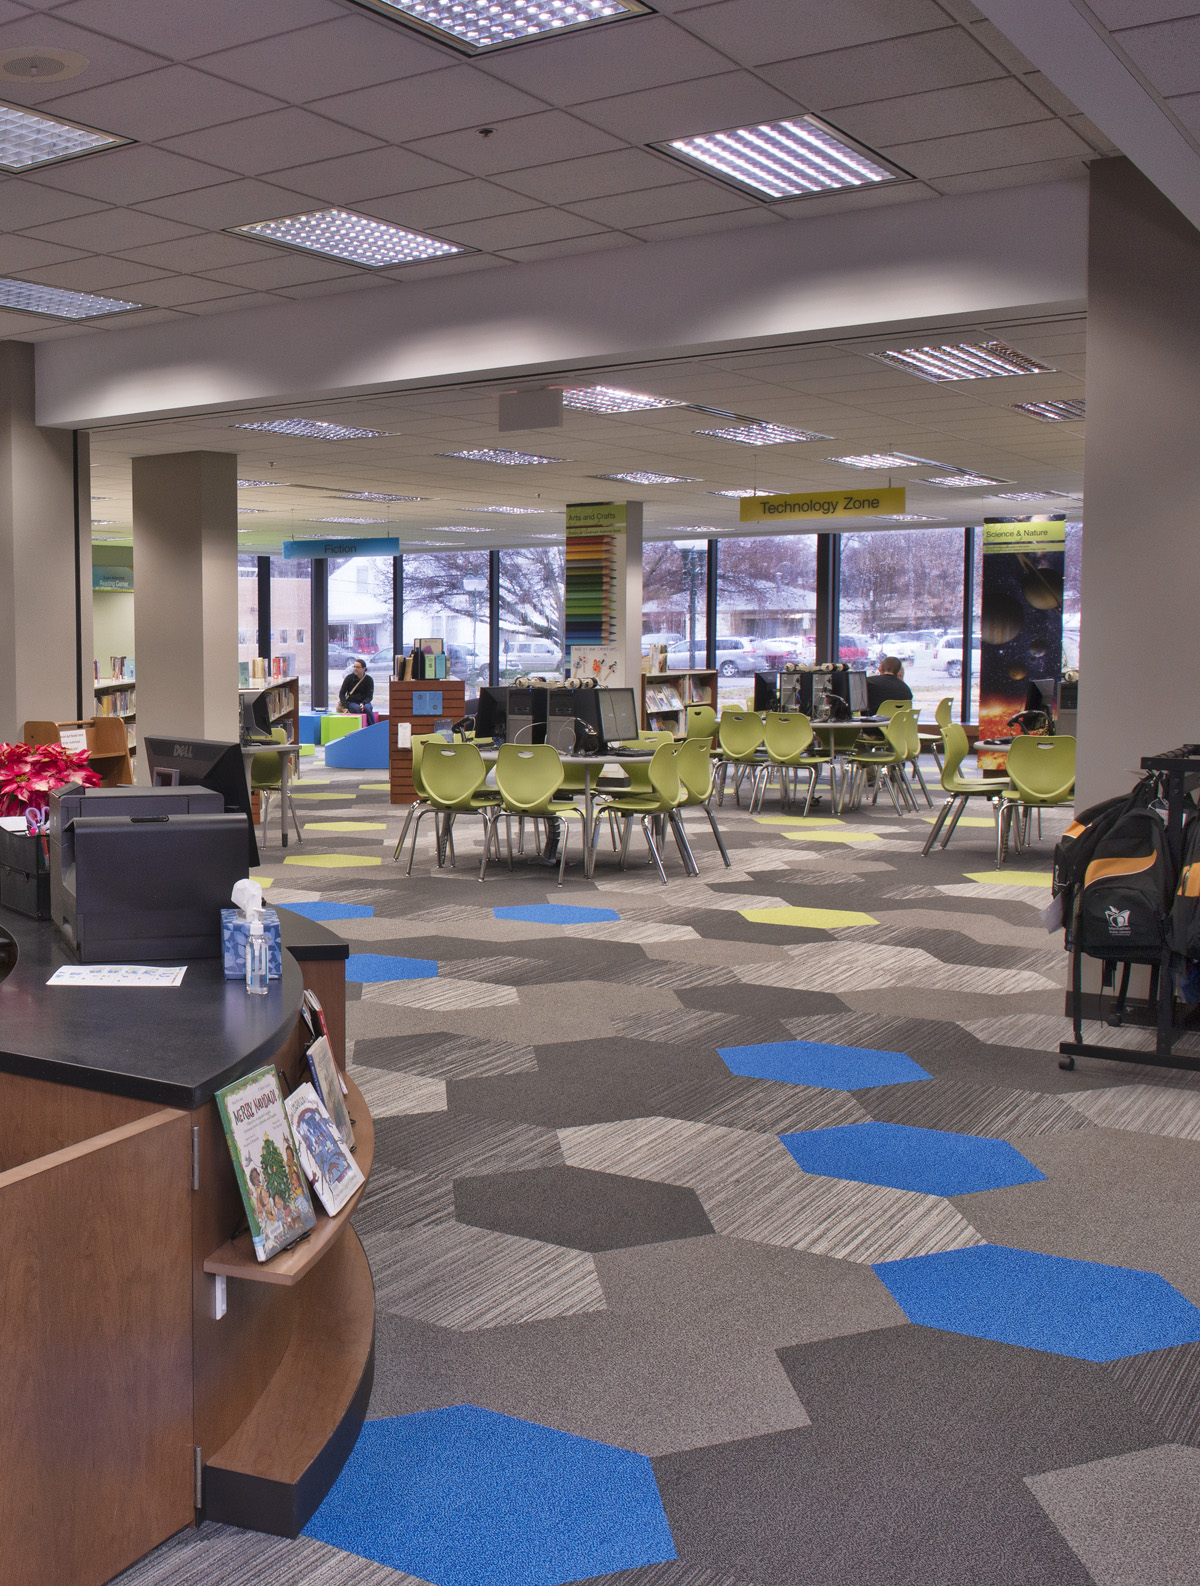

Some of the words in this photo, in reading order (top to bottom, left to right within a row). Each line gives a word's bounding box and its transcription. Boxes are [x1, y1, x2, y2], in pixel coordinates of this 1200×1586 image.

[760, 499, 839, 515] Technology
[843, 497, 880, 510] Zone
[596, 512, 616, 520] Crafts
[1024, 529, 1048, 537] Nature
[324, 544, 357, 554] Fiction
[173, 744, 193, 758] DELL
[233, 1102, 254, 1126] MERRY
